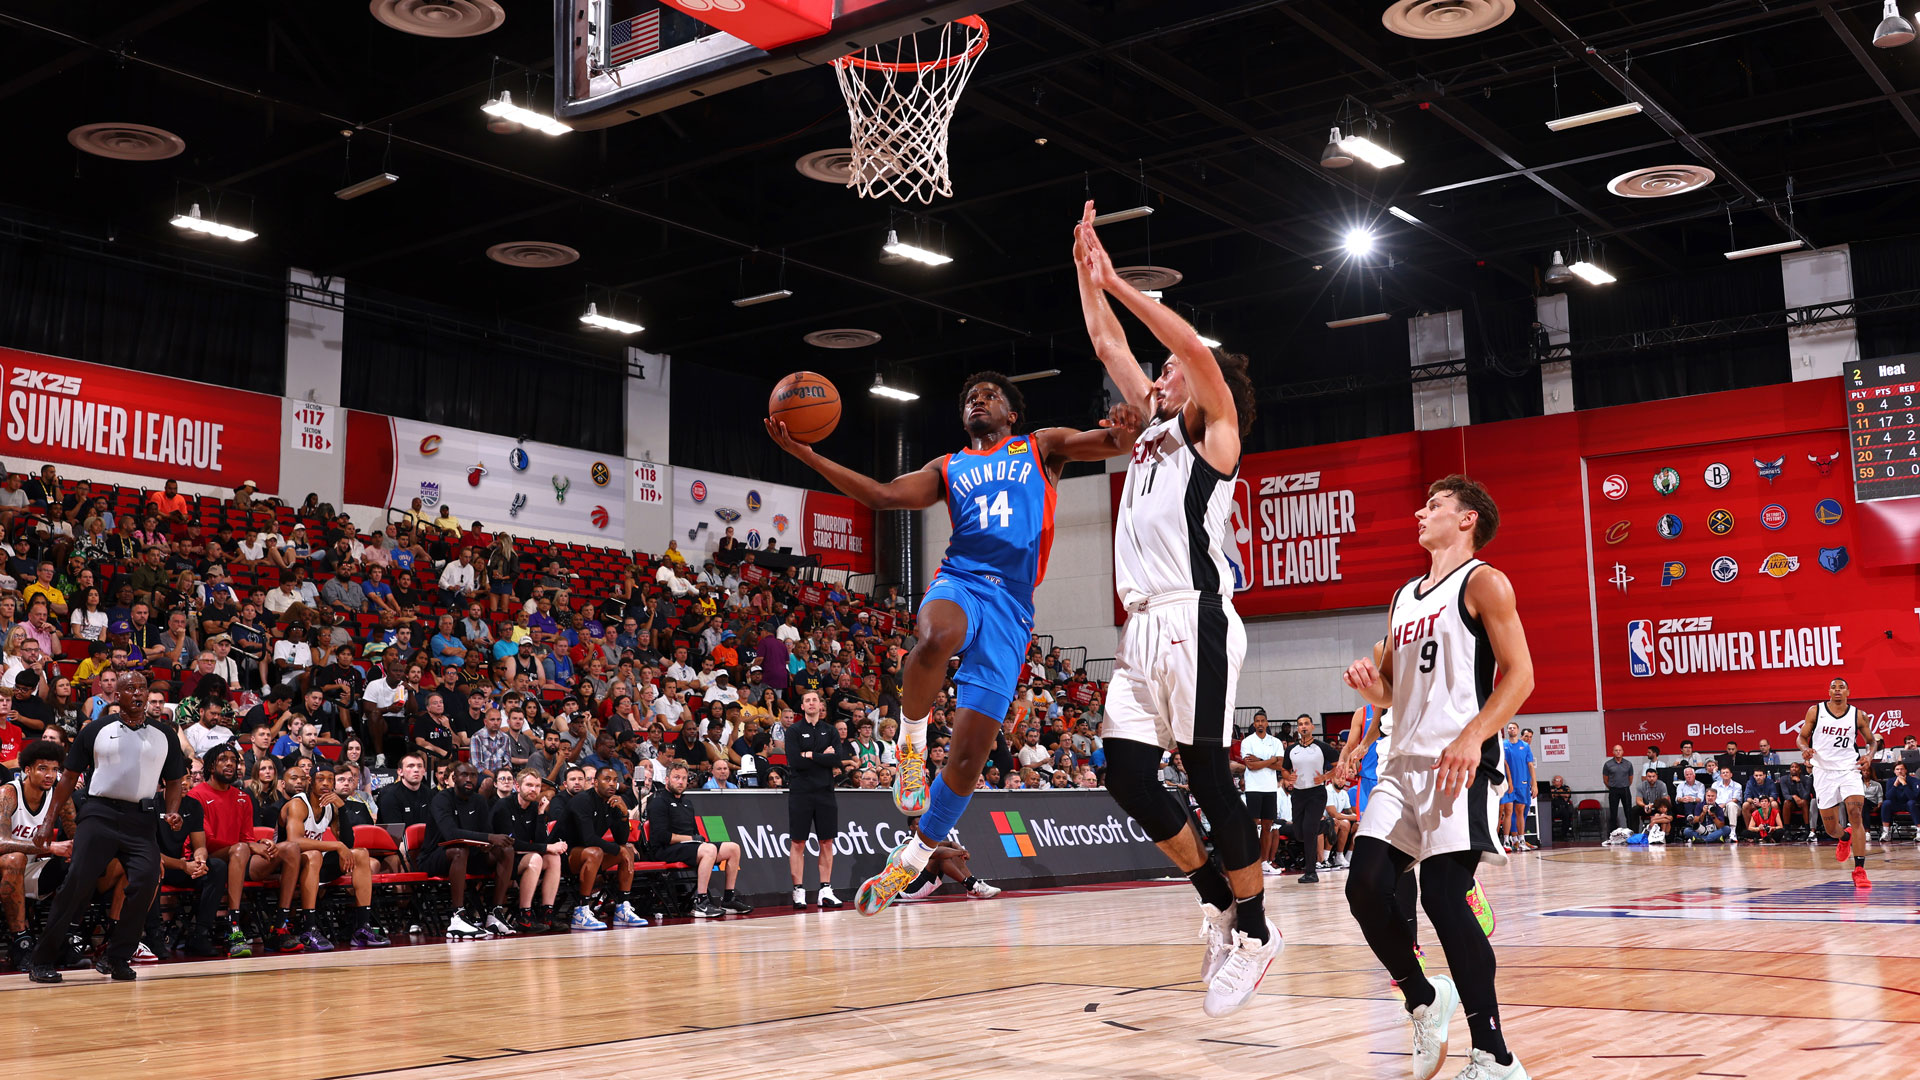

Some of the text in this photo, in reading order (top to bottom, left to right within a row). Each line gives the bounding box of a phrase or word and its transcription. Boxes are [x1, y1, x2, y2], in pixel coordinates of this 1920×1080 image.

[1853, 369, 1861, 380] 2
[1878, 363, 1906, 377] Heat
[10, 367, 82, 396] 2K25
[778, 385, 826, 401] Wilson
[1851, 385, 1915, 399] PLY PTS REB
[1856, 395, 1912, 412] 9 4 3
[303, 409, 325, 426] 117
[1856, 413, 1914, 429] 11 17 3
[7, 390, 224, 472] SUMMER LEAGUE
[1856, 430, 1916, 446] 17 4 2
[301, 433, 323, 450] 118
[1131, 428, 1170, 464] EAT
[1857, 446, 1917, 462] 20 7 4
[640, 468, 656, 482] 118
[952, 460, 1032, 498] THUNDER
[1140, 462, 1158, 496] 11
[1859, 464, 1920, 478] 59 0 0
[1259, 471, 1321, 495] 2K25
[640, 488, 656, 502] 119
[974, 490, 1013, 529] 14
[1259, 489, 1356, 542] SUMMER
[813, 513, 852, 535] TOMORROW'S
[813, 530, 863, 553] STARS PLAY HERE
[1261, 537, 1342, 587] LEAGUE
[1762, 559, 1796, 571] LAKERS
[1393, 604, 1447, 651] HEAT
[1658, 616, 1713, 634] 2K25
[1419, 640, 1438, 674] 9
[1658, 626, 1844, 675] SUMMER LEAGUE
[1633, 663, 1647, 674] NBA
[1868, 710, 1910, 735] Vegas
[1888, 710, 1901, 719] LAS
[1622, 731, 1666, 742] Hennessy
[1702, 722, 1755, 735] Hotels.com
[1822, 726, 1851, 737] HEAT
[1833, 736, 1850, 748] 20
[737, 820, 875, 859] Micooft
[1030, 815, 1129, 847] Microsoft
